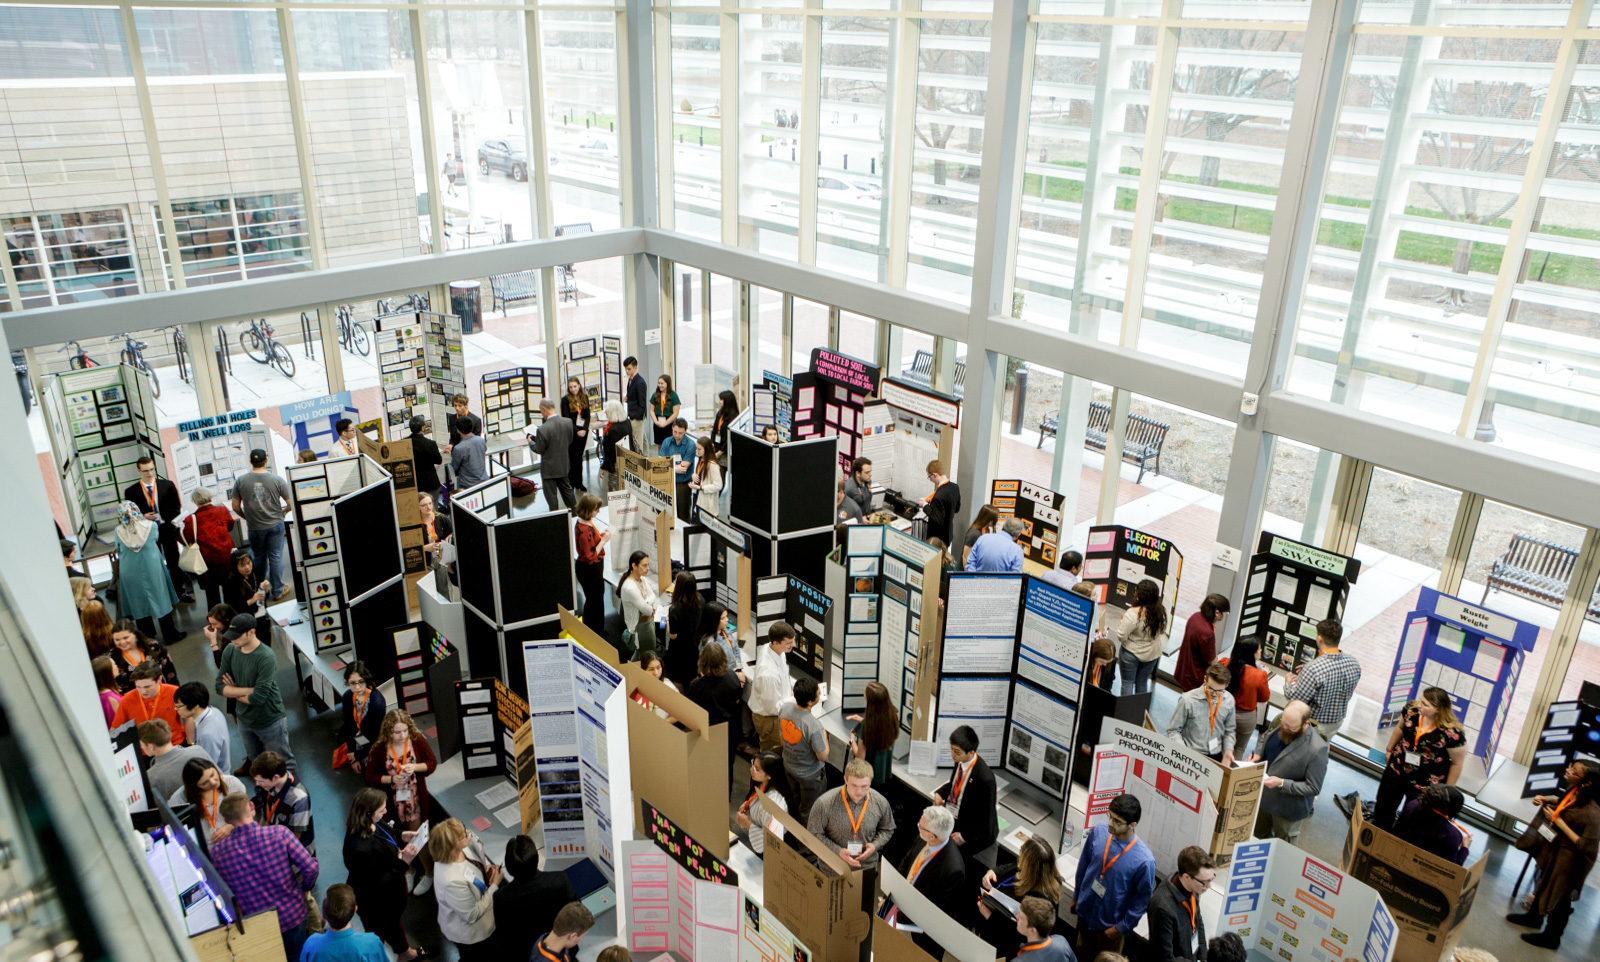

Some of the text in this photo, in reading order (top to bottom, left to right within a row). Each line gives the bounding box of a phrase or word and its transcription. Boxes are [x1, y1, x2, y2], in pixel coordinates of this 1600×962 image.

[820, 350, 866, 372] POLLUTED SOIL:
[820, 360, 847, 375] COMPARISON
[854, 372, 870, 382] LOCAL
[817, 366, 827, 376] SOIL
[834, 372, 848, 383] LOCAL
[849, 378, 862, 388] FARM
[863, 380, 874, 391] SOIL
[290, 404, 344, 423] YOU DOING?
[294, 394, 338, 411] HOW ARE
[178, 410, 257, 432] FILLING IN HOLES
[189, 422, 252, 441] IN WELL LOGS
[624, 470, 641, 488] HAND
[650, 486, 672, 506] PHONE
[1023, 486, 1050, 501] MAG
[1124, 529, 1166, 552] ELECTRIC
[1284, 542, 1304, 552] Electricity
[1311, 549, 1332, 560] Generated
[1126, 542, 1160, 562] MOTOR
[1281, 548, 1334, 570] SWAG?
[790, 578, 831, 608] OPPOSITE
[799, 595, 823, 614] WINDS
[1463, 607, 1489, 621] Rustic
[1460, 614, 1488, 629] Weight
[1114, 727, 1210, 778] SUBATOMIC PARTICLE
[1119, 739, 1200, 781] PROPORTIONALITY
[1155, 789, 1175, 804] RESULTS
[652, 823, 681, 856] FRESH
[652, 808, 676, 837] THAT
[712, 860, 727, 876] SO
[1369, 872, 1441, 913] Tri-Fold Display Board
